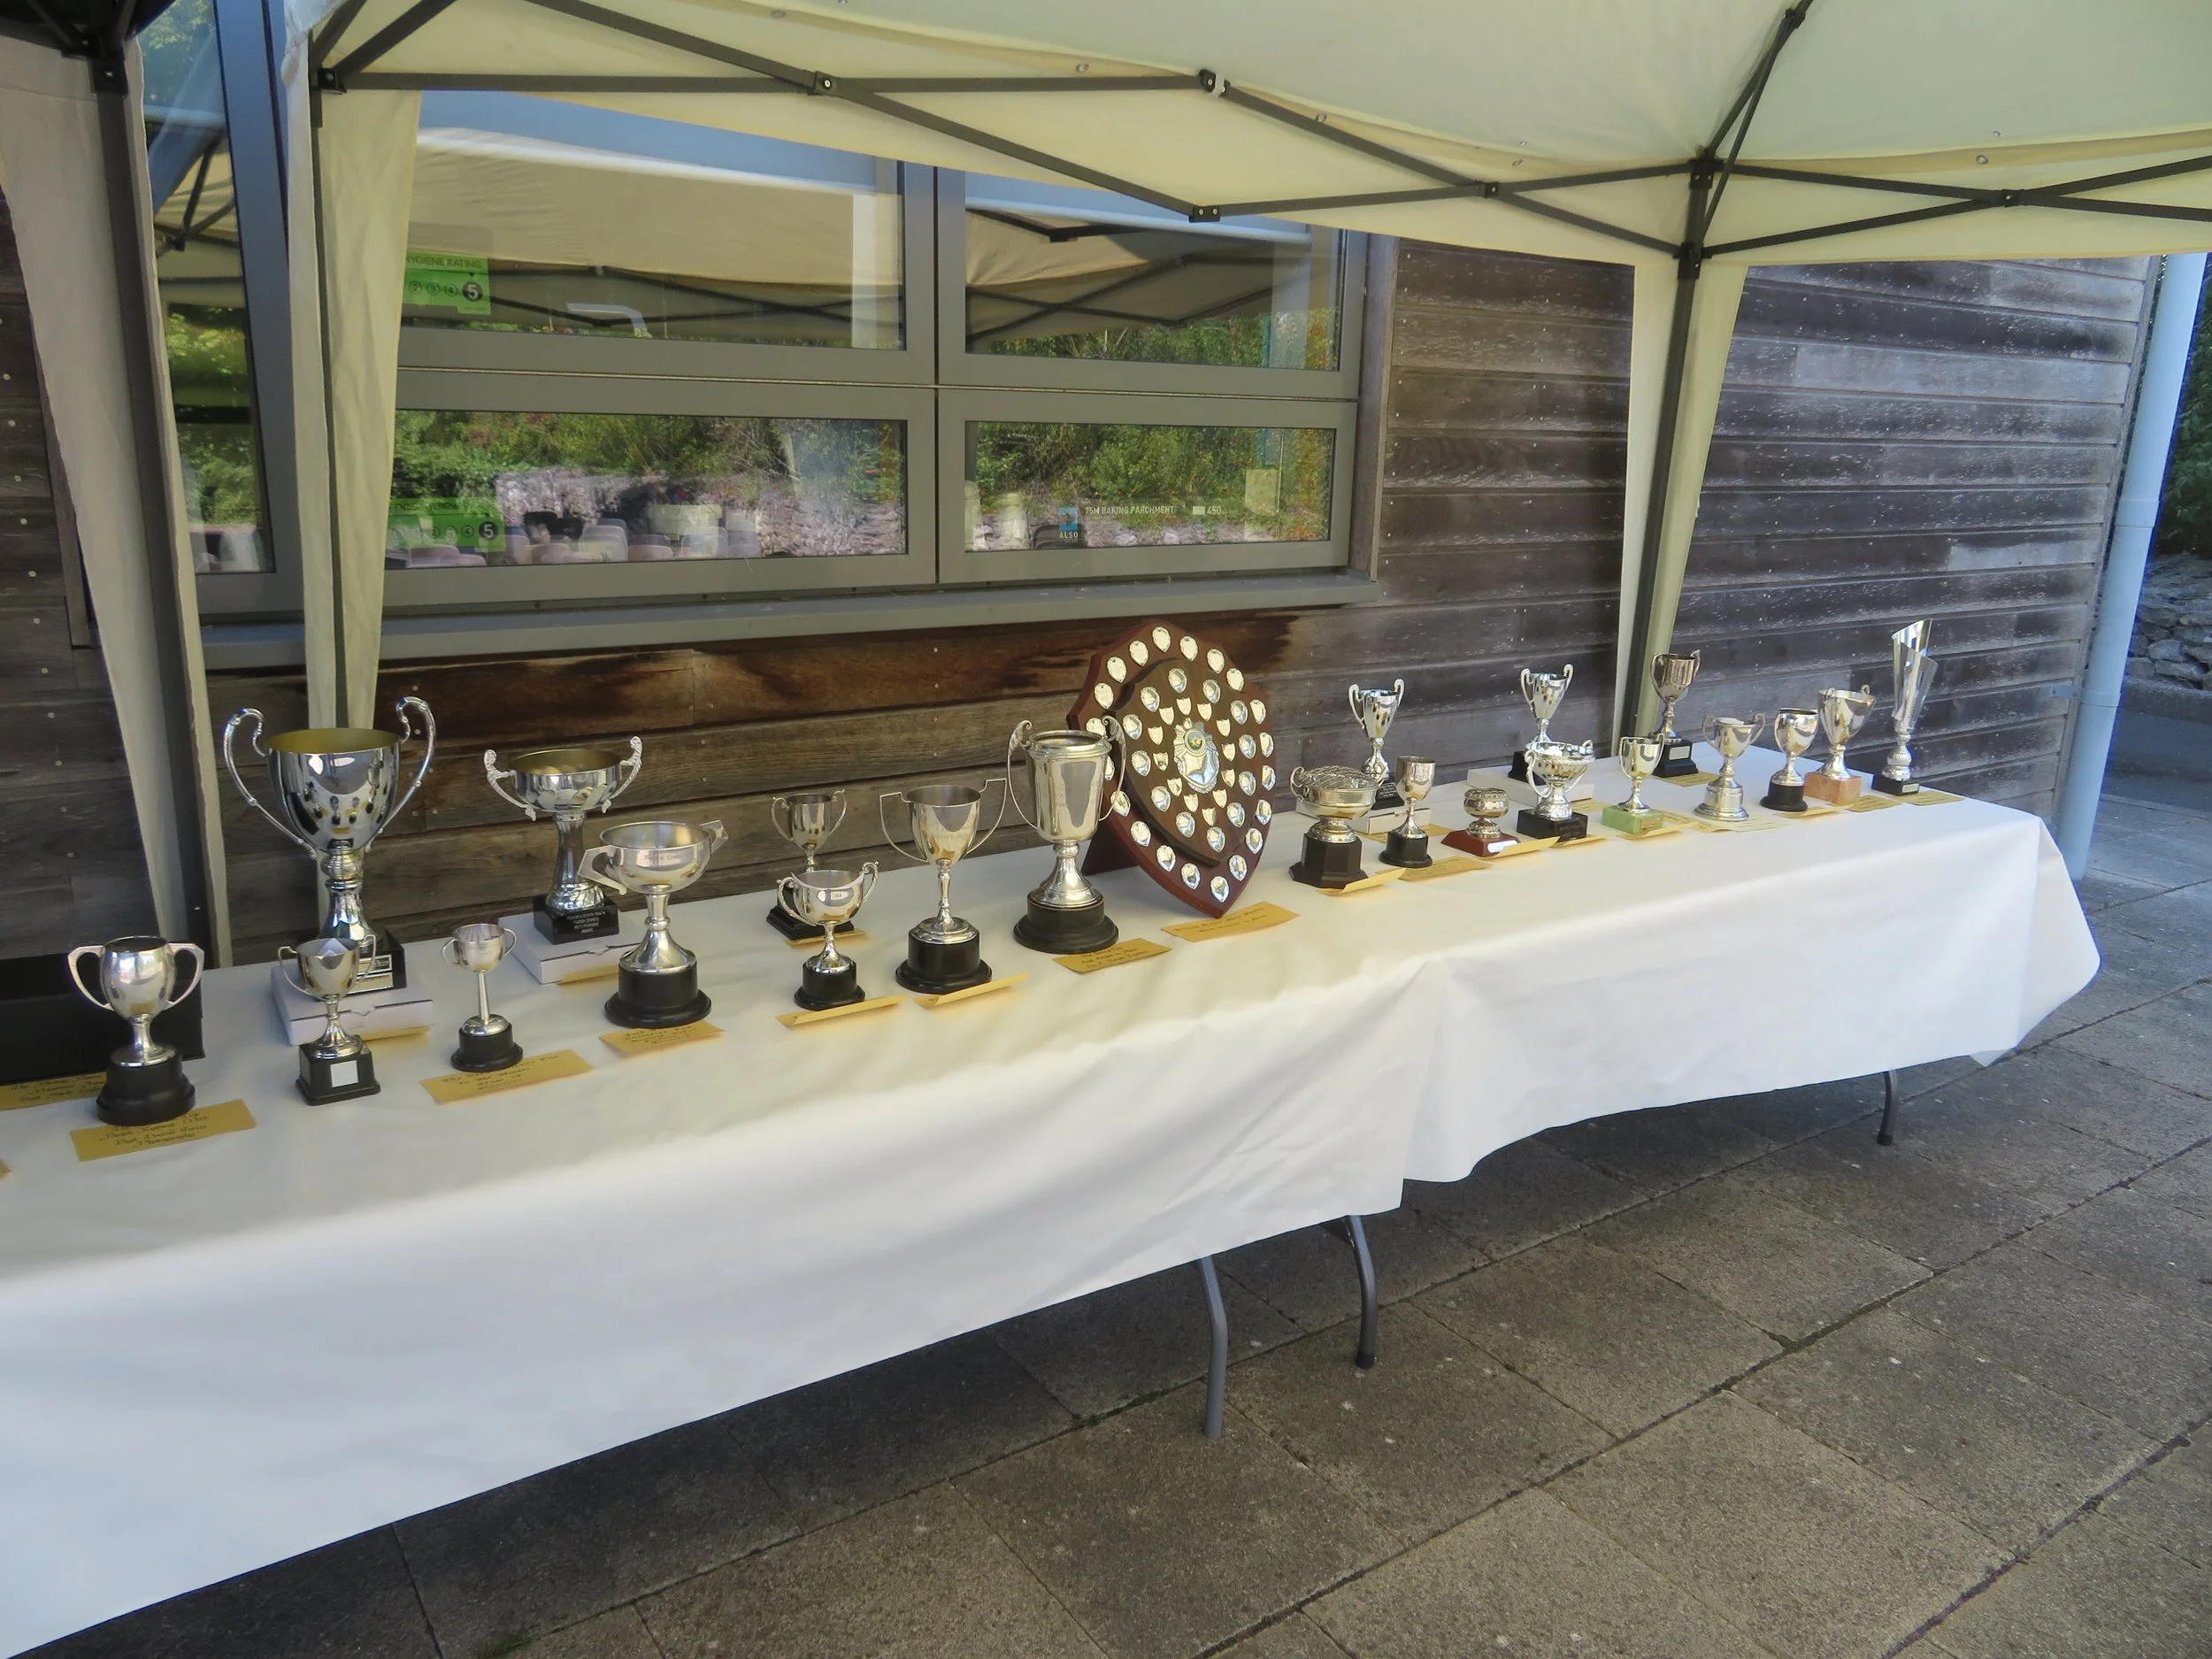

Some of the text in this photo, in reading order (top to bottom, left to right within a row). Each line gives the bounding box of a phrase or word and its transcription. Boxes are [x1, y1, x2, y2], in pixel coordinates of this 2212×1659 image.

[447, 257, 482, 269] RATING
[467, 283, 479, 300] 5
[1085, 505, 1175, 515] 75M BAKING PARCHMENT
[1207, 505, 1222, 515] 450
[483, 523, 495, 539] 5
